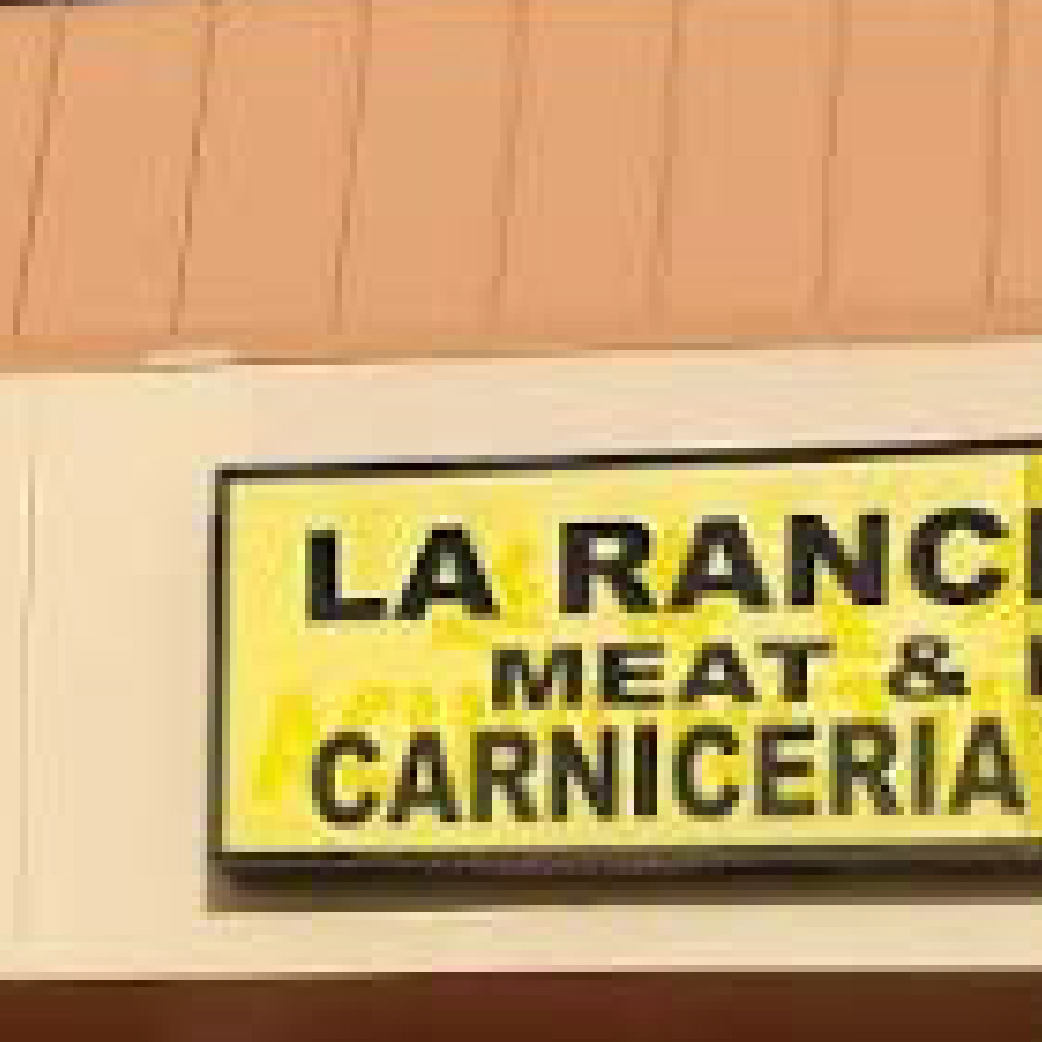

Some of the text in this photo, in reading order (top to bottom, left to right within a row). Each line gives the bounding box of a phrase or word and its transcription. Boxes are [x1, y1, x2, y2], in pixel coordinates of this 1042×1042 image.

[304, 524, 496, 622] LA
[491, 642, 828, 710] MEAT
[886, 634, 970, 702] &
[312, 716, 1025, 825] CARNICERIA
